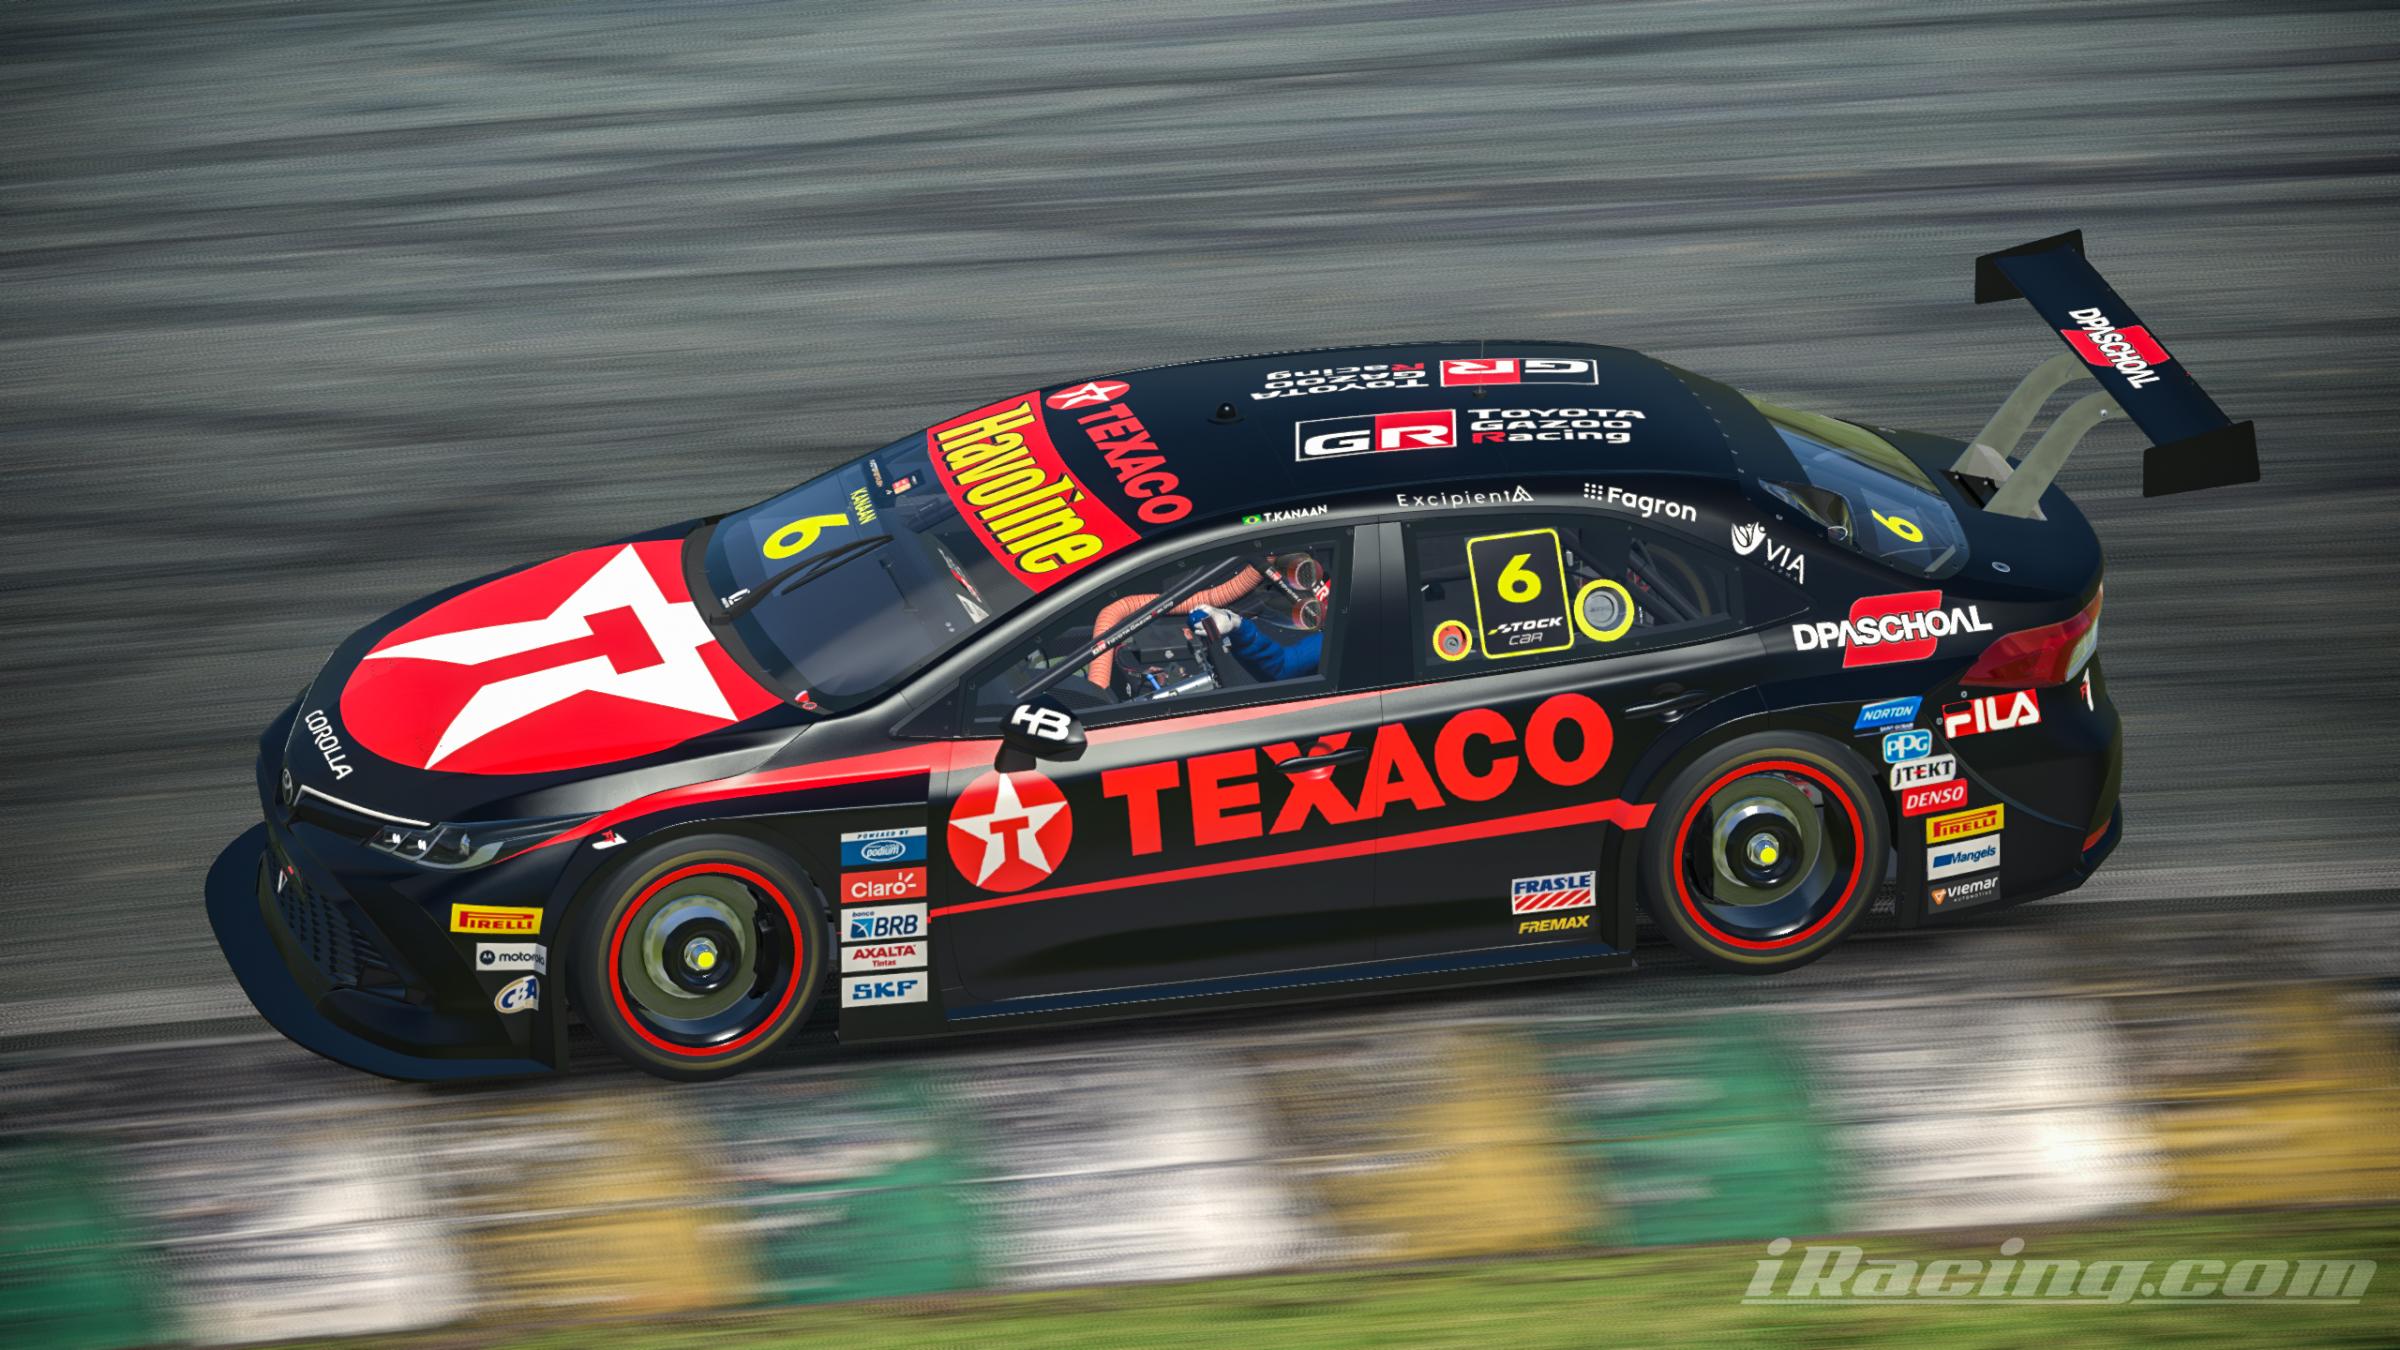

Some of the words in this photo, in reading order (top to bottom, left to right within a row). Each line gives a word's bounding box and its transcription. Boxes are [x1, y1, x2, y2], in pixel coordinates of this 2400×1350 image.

[2068, 307, 2160, 389] DPASCHOAL
[1266, 362, 1425, 380] Racing
[1447, 360, 1588, 375] GR
[1250, 379, 1429, 401] TOYOTA
[1264, 371, 1426, 390] GAZOO
[1467, 408, 1646, 419] TOYOTA
[1470, 420, 1632, 431] GAZOO
[1471, 429, 1631, 444] Racing
[1303, 424, 1448, 456] GR
[1076, 402, 1193, 524] TEXACO
[934, 401, 1104, 574] Havoline
[850, 486, 877, 525] KANAAN
[1263, 504, 1327, 522] T.KANAAN
[1607, 486, 1697, 523] Fagron
[762, 513, 849, 560] 6
[1871, 509, 1924, 543] 6
[1767, 538, 1804, 584] VIA
[1497, 553, 1542, 603] 6
[1488, 616, 1563, 636] STOCK
[1792, 605, 1993, 651] DPASCHOAL
[1863, 705, 1914, 721] NORTON
[1944, 691, 2040, 739] FILA
[305, 709, 353, 780] COROLLA
[1887, 734, 1929, 759] PPG
[1101, 692, 1614, 857] TEXACO
[1895, 759, 1954, 787] JTEKT
[1906, 786, 1965, 810] DENSO
[1933, 810, 1998, 839] PIRELLI
[1950, 845, 1997, 864] Mangels
[851, 880, 907, 899] Claro
[459, 911, 535, 930] PIRELLI
[874, 914, 919, 937] BRB
[1518, 914, 1591, 935] FREMAX
[852, 944, 917, 961] AXALTA
[872, 958, 897, 968] Tintas
[852, 979, 919, 1001] SKF
